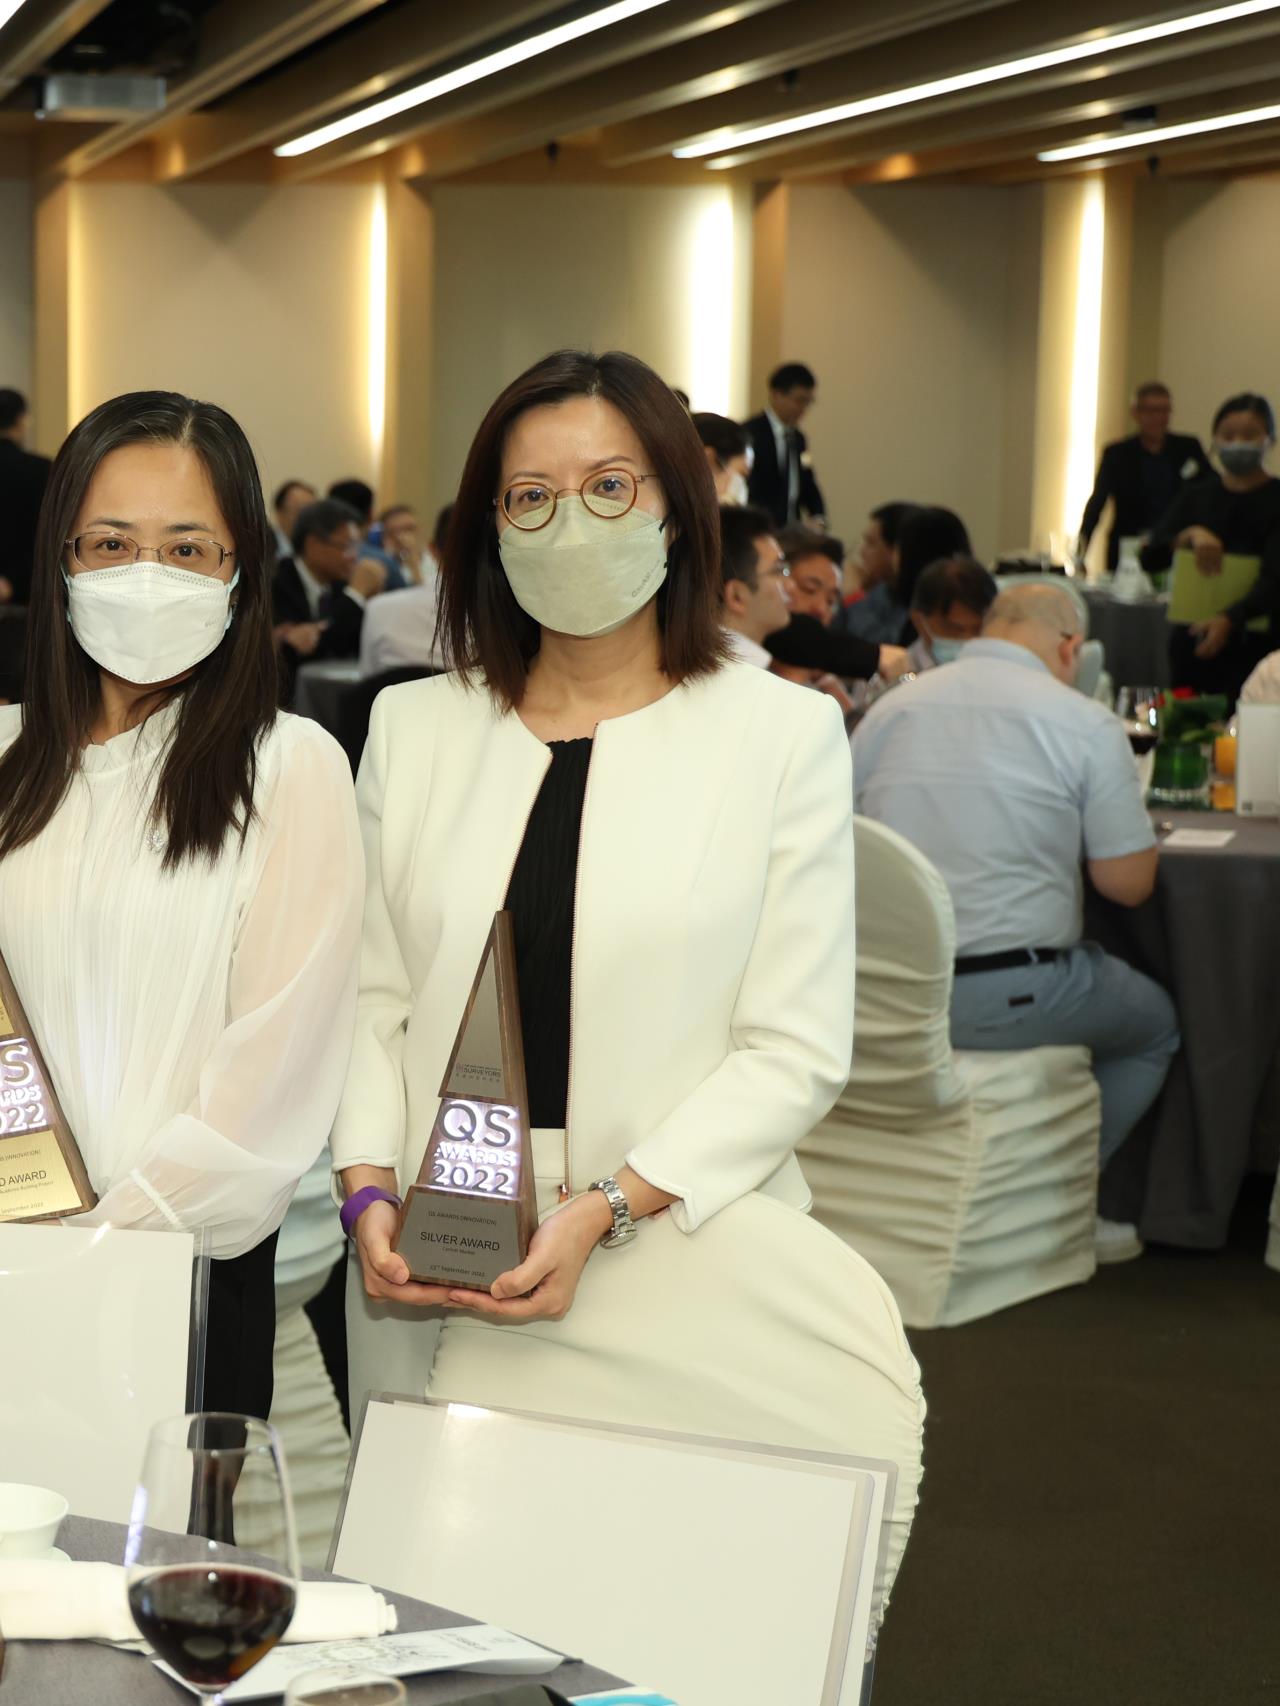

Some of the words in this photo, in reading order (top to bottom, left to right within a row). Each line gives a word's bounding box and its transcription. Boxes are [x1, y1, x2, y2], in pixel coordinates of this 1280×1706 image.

[439, 1102, 513, 1147] QS
[433, 1142, 517, 1167] AWARDS
[8, 1170, 47, 1185] AWARD
[431, 1163, 513, 1195] 2022
[420, 1231, 458, 1245] SILVER
[460, 1237, 500, 1251] AWARD
